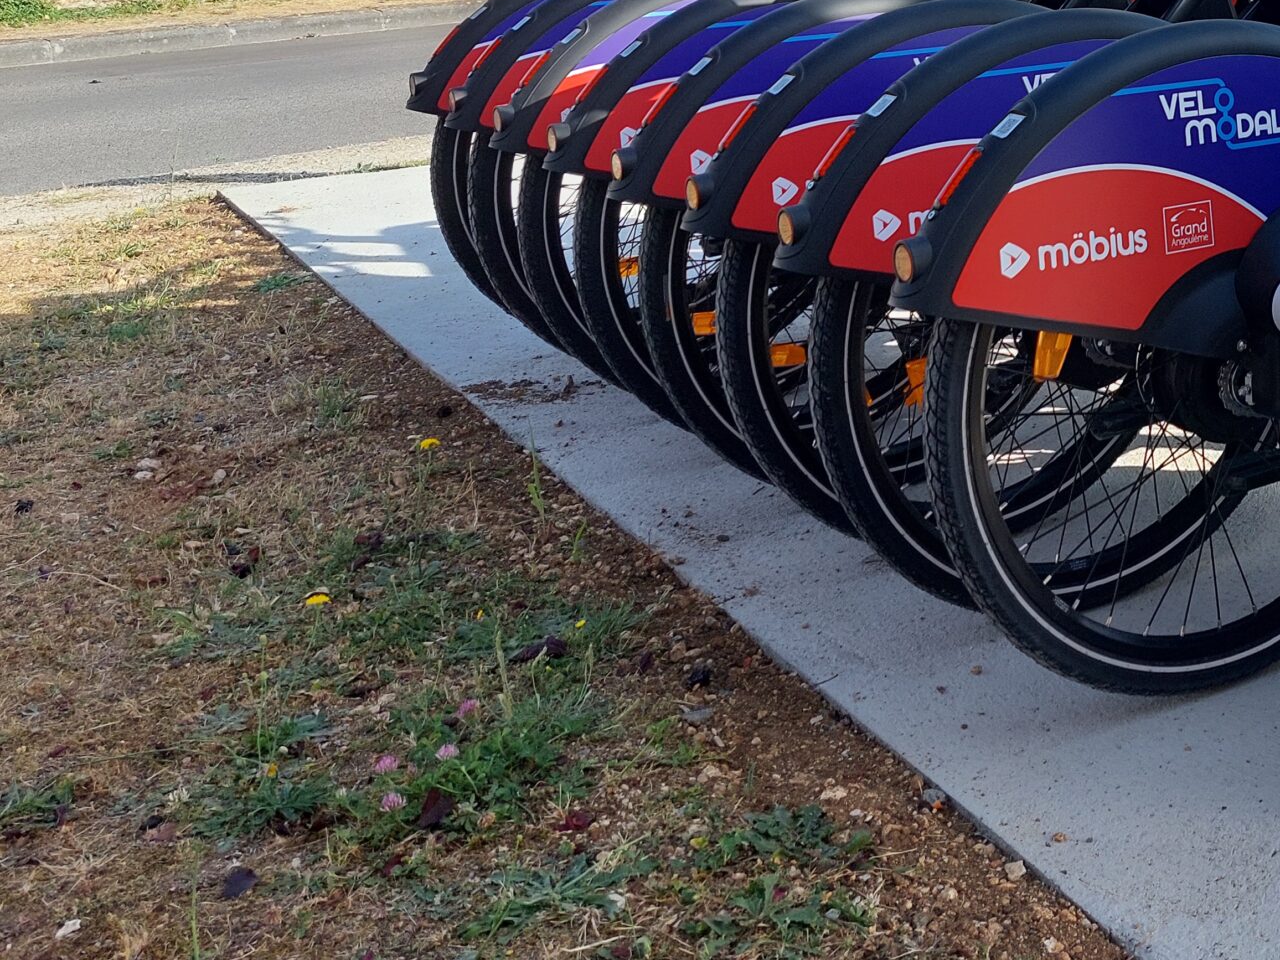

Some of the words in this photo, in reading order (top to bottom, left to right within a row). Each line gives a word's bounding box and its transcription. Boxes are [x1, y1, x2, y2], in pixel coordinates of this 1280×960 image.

[1171, 216, 1208, 238] Grand
[1037, 226, 1148, 272] möbius
[1171, 234, 1209, 248] Angoulême
